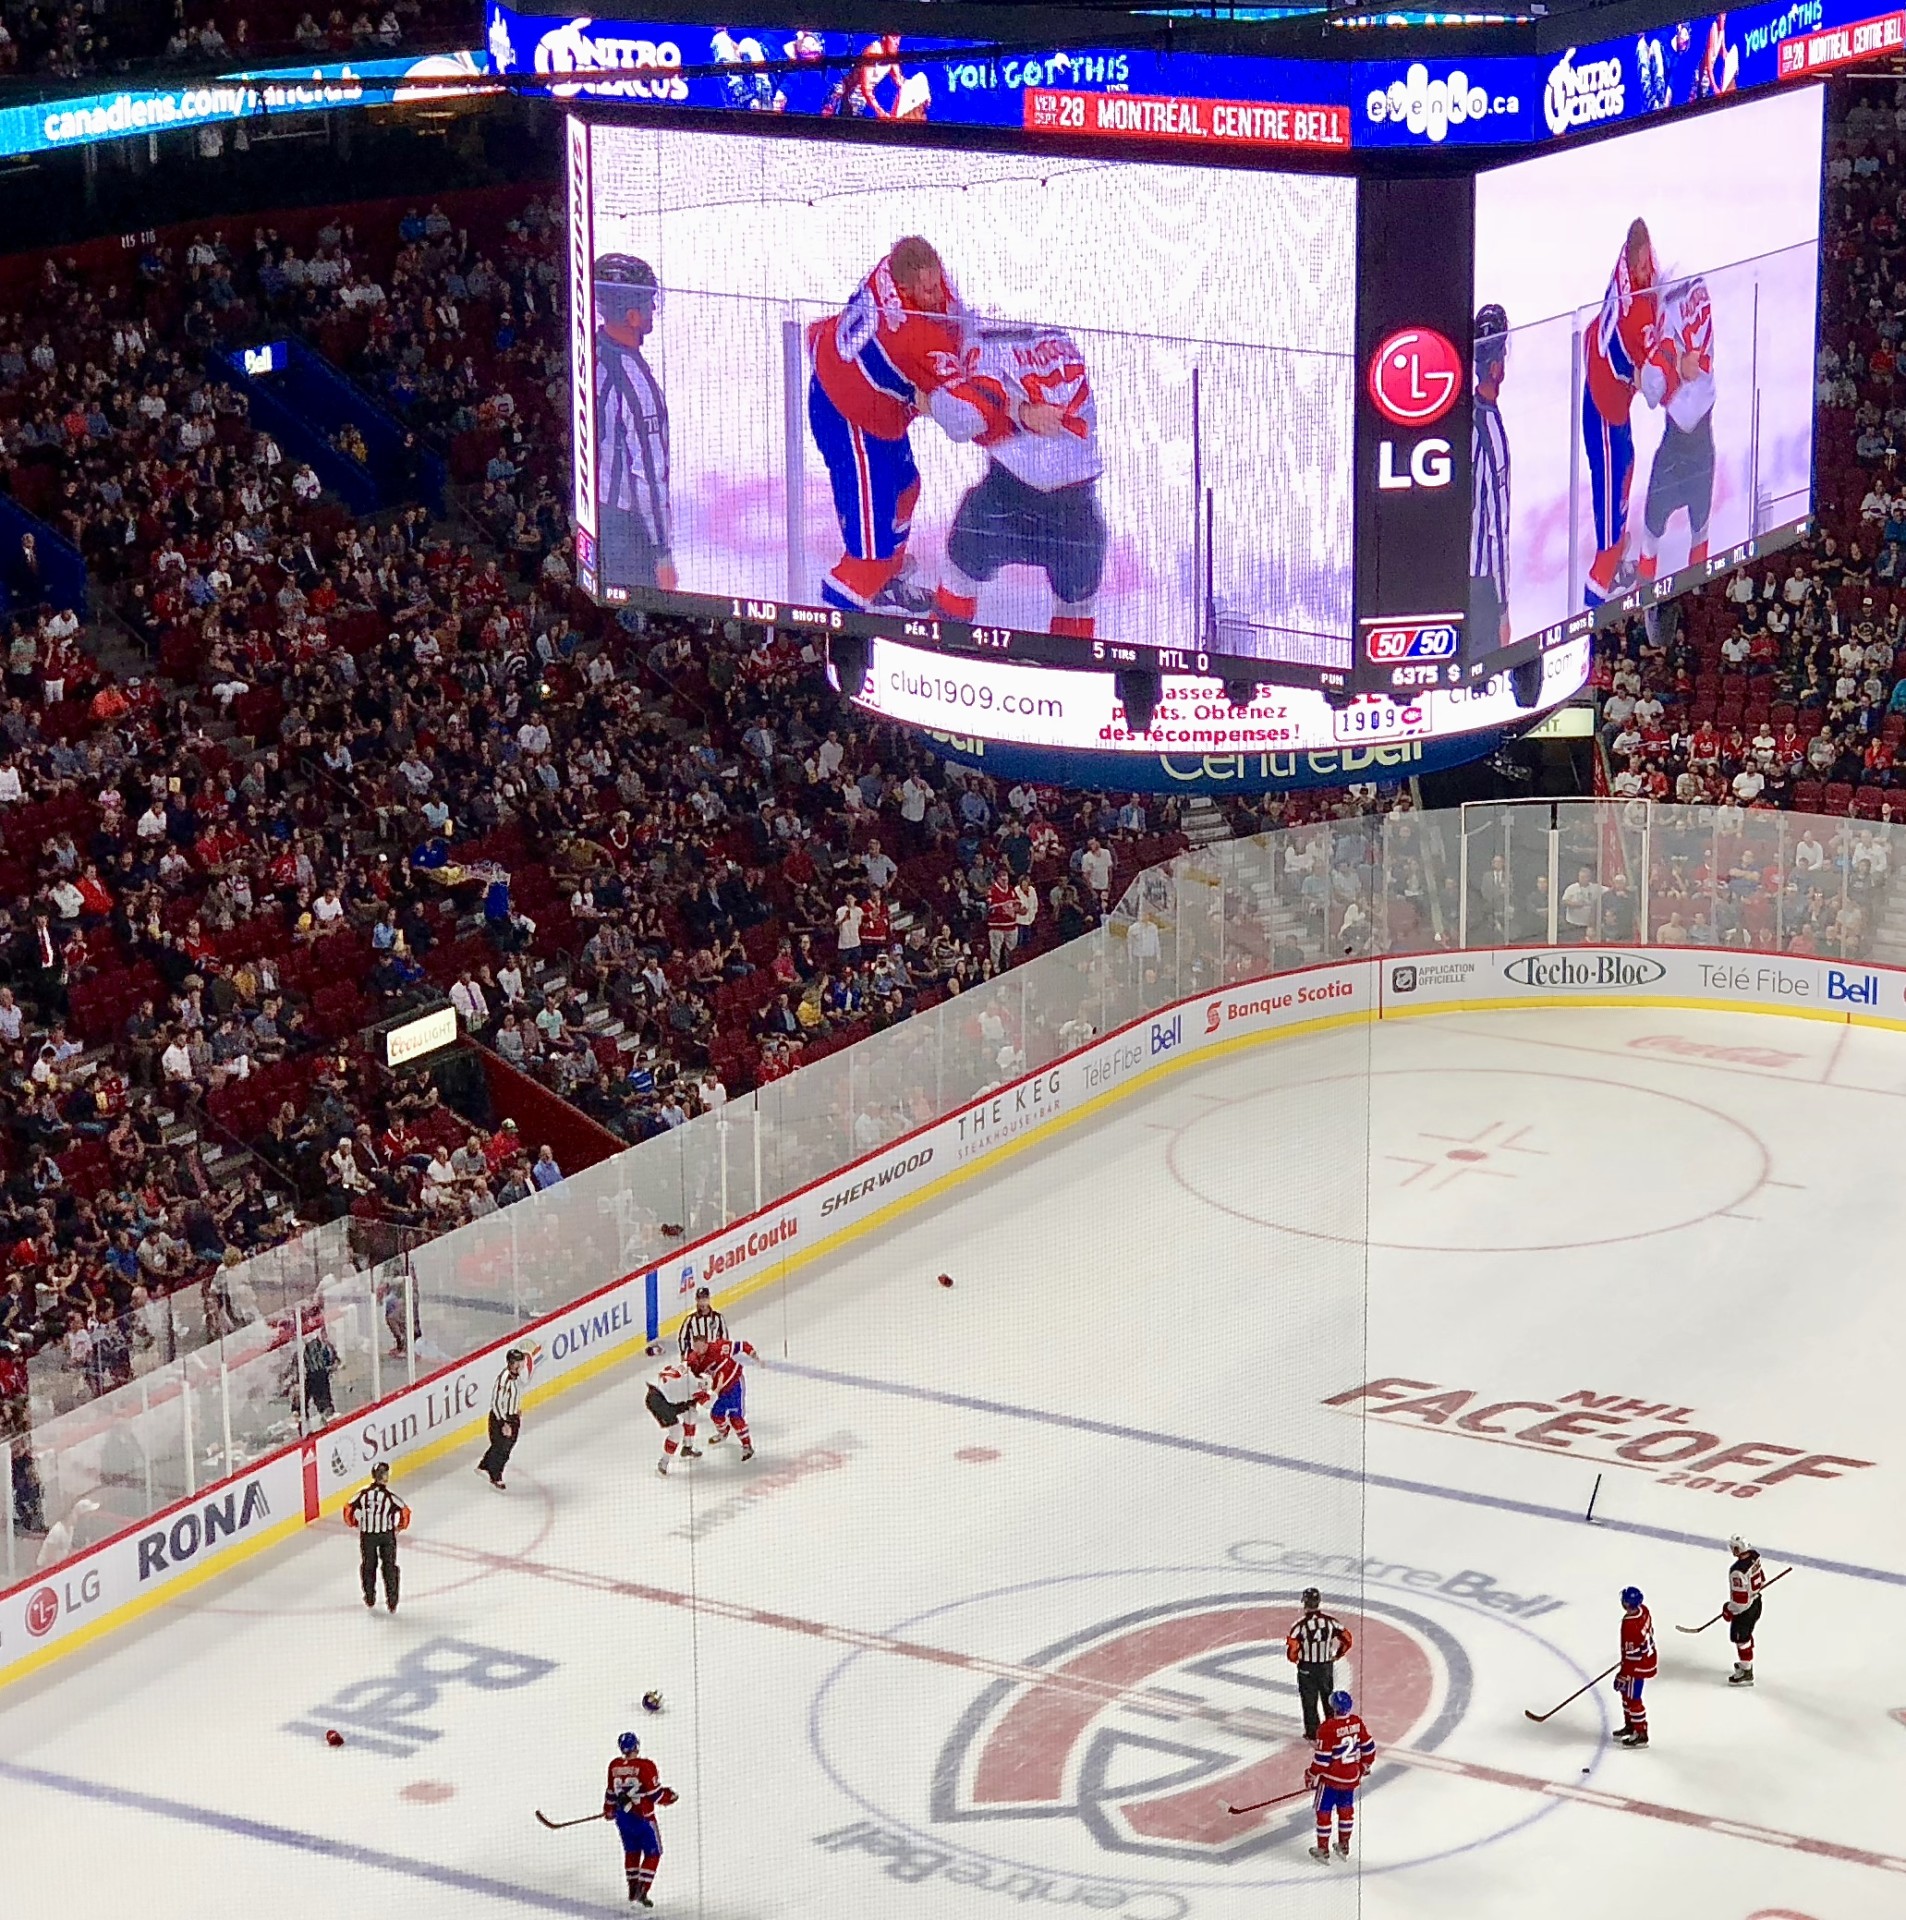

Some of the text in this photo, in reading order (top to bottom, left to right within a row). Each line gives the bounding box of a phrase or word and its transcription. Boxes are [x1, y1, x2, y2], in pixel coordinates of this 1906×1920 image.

[580, 37, 682, 70] NITRO
[1745, 25, 1768, 57] YOU
[1854, 21, 1883, 54] CENTRE
[1884, 17, 1903, 46] BELL
[944, 54, 1129, 92] YOU GOT THIS
[1571, 57, 1622, 96] NITRO
[1059, 96, 1343, 143] 28 MONTRÉAL, CENTRE BELL
[1567, 85, 1625, 125] CIRCUS
[244, 345, 273, 375] Bell
[1379, 438, 1452, 489] LG
[1654, 577, 1673, 598] 4:17
[733, 599, 842, 628] 1 NJD SHOTS 6
[932, 622, 940, 640] 1
[972, 628, 1010, 648] 4:17
[1093, 641, 1209, 671] 5 TIRS MTL 0
[1392, 663, 1461, 685] 6375 $
[890, 670, 1063, 718] club1909.com
[1194, 704, 1288, 721] Obtenez
[1099, 725, 1136, 741] des
[1418, 963, 1475, 977] APPLICATION
[1418, 973, 1467, 986] OFFICIELLE
[1522, 956, 1648, 985] Techo-Bloc
[1698, 963, 1810, 996] Télé Fibe
[1827, 970, 1878, 1006] Bell
[1228, 980, 1353, 1020] Banque Scotia
[424, 1021, 452, 1043] LIGHT
[1151, 1014, 1182, 1055] Bell
[1083, 1045, 1143, 1090] Télé Fibe
[958, 1071, 1060, 1141] THE KEG
[821, 1147, 934, 1217] SHER-WOOD
[703, 1217, 798, 1281] Jean Coutu
[552, 1301, 632, 1360] OLYMEL
[362, 1373, 479, 1463] Sun Life
[1555, 1389, 1695, 1424] NHL
[1322, 1377, 1877, 1485] FACE-OFF
[1655, 1471, 1762, 1499] 2018
[138, 1480, 271, 1582] RONA
[65, 1569, 100, 1614] LG
